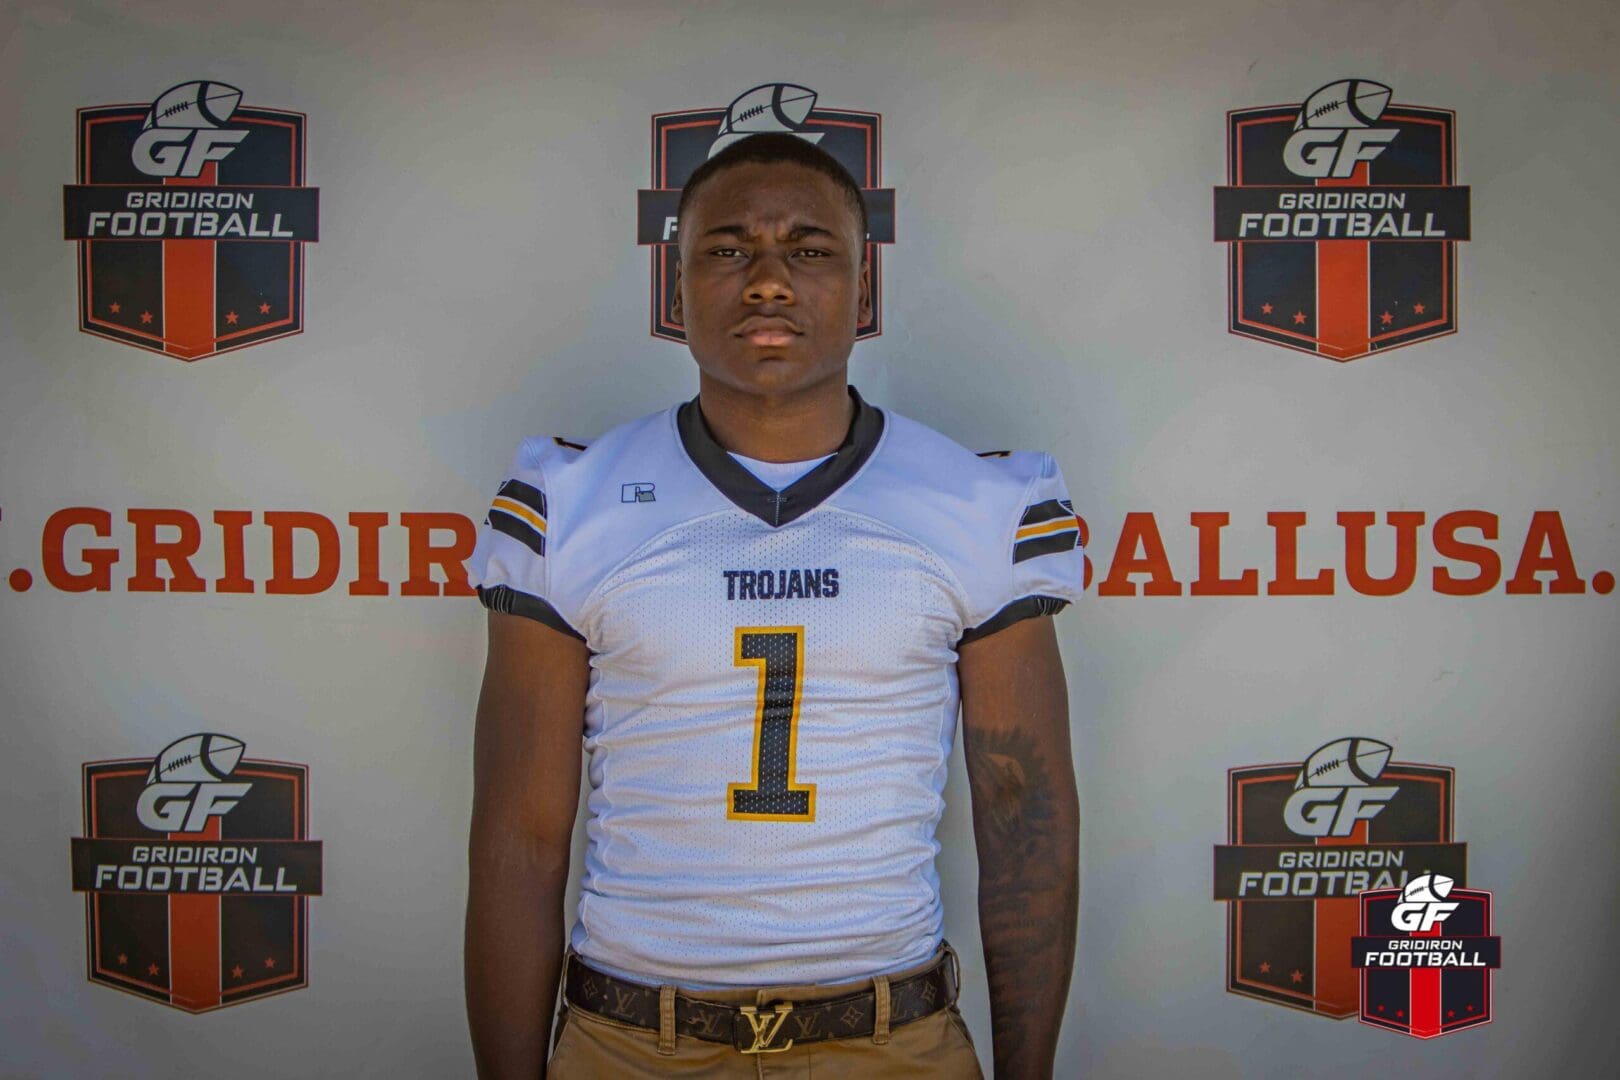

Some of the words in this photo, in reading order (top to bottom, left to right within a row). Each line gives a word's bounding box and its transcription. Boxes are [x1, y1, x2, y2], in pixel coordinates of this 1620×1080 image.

[131, 129, 250, 177] GF
[1283, 128, 1400, 178] GF
[126, 191, 254, 209] GRIDIRON
[1278, 192, 1406, 210] GRIDIRON
[87, 211, 294, 238] FOOTBALL
[1238, 212, 1446, 238] FOOTBALL
[0, 507, 479, 597] .GRIDIR
[723, 568, 840, 600] TROJANS
[726, 625, 817, 823] 1
[136, 782, 253, 832] GF
[1283, 786, 1400, 837] GF
[132, 846, 258, 865] GRIDIRON
[1278, 850, 1404, 869] GRIDIRON
[95, 865, 298, 892] FOOTBALL
[1238, 870, 1430, 897] FOOTBA
